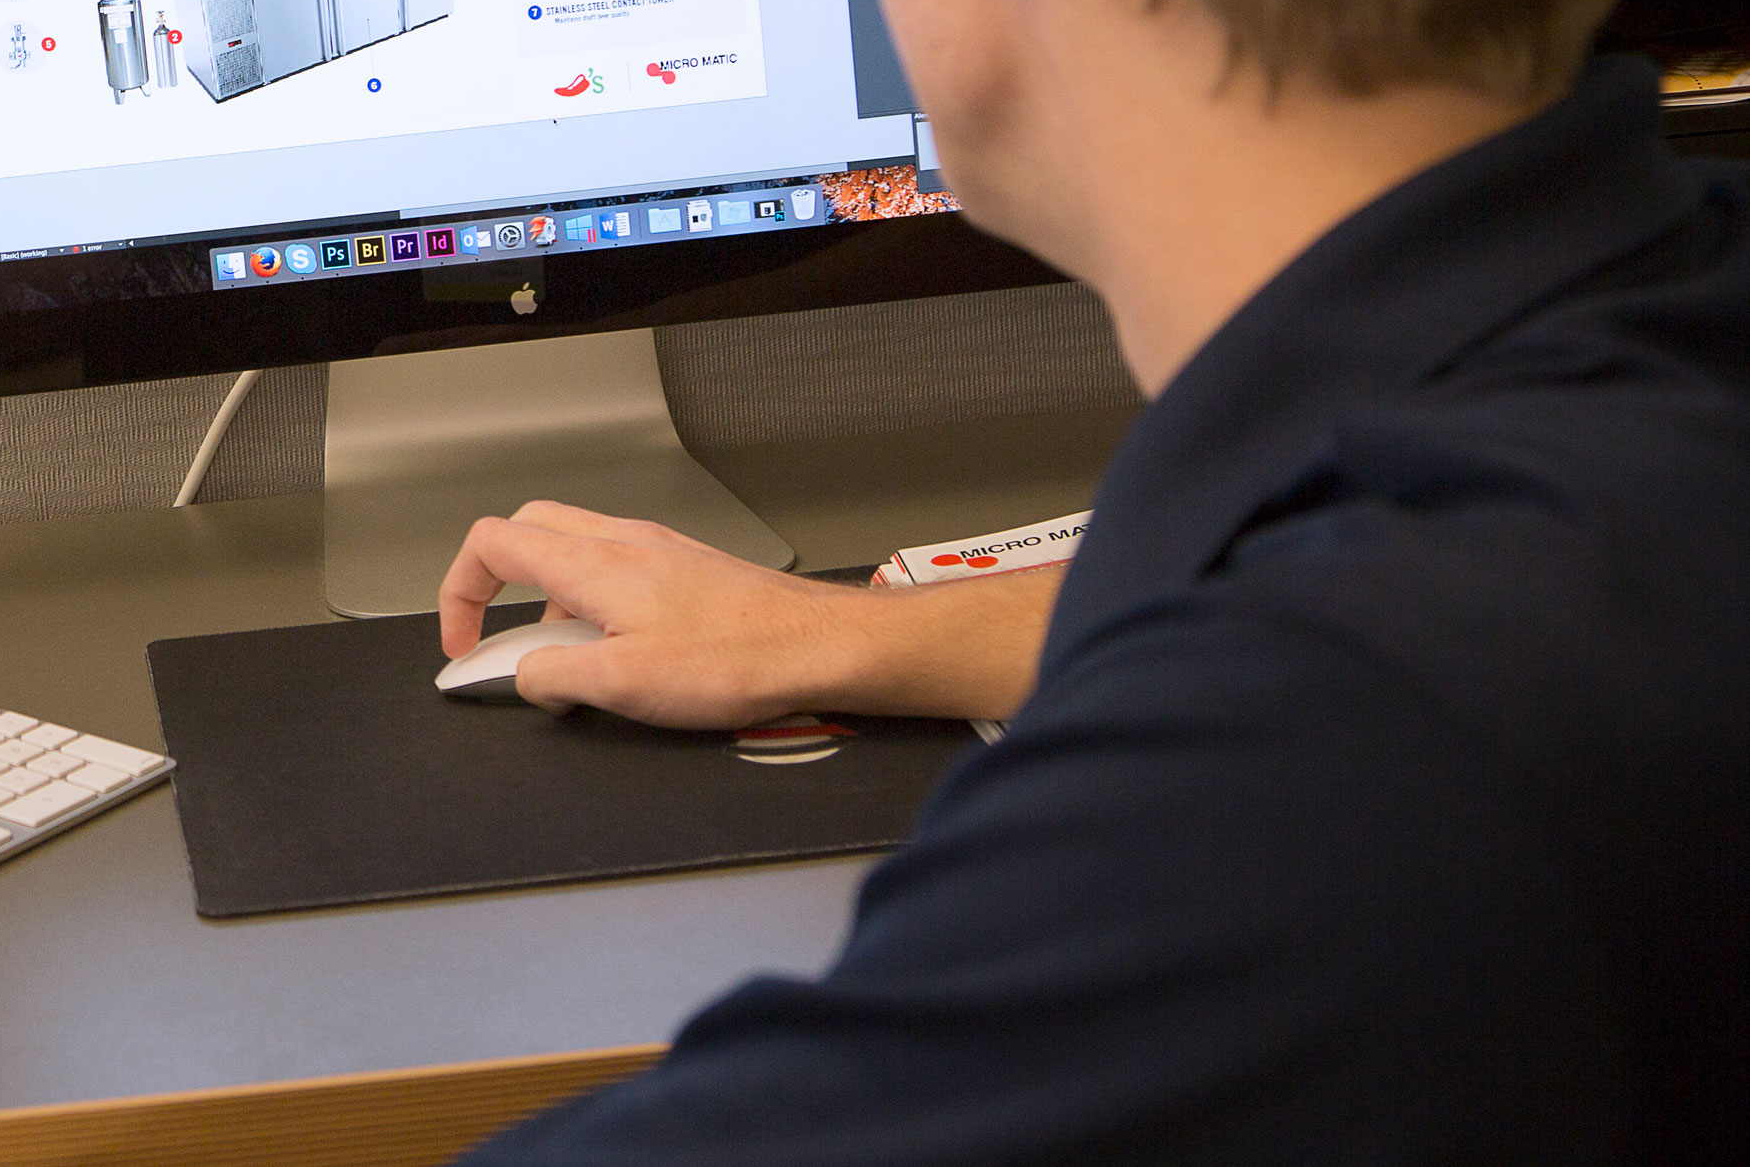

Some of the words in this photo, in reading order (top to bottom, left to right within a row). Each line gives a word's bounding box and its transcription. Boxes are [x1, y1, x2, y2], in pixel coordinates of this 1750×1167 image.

[546, 3, 585, 15] STAINLESS
[587, 1, 609, 11] STEEL
[659, 58, 699, 72] MICRO
[702, 53, 737, 65] MATIC
[397, 240, 413, 254] Pr
[432, 235, 447, 250] Id
[327, 247, 345, 262] Ps
[362, 243, 379, 258] Br
[960, 536, 1042, 559] MICRO
